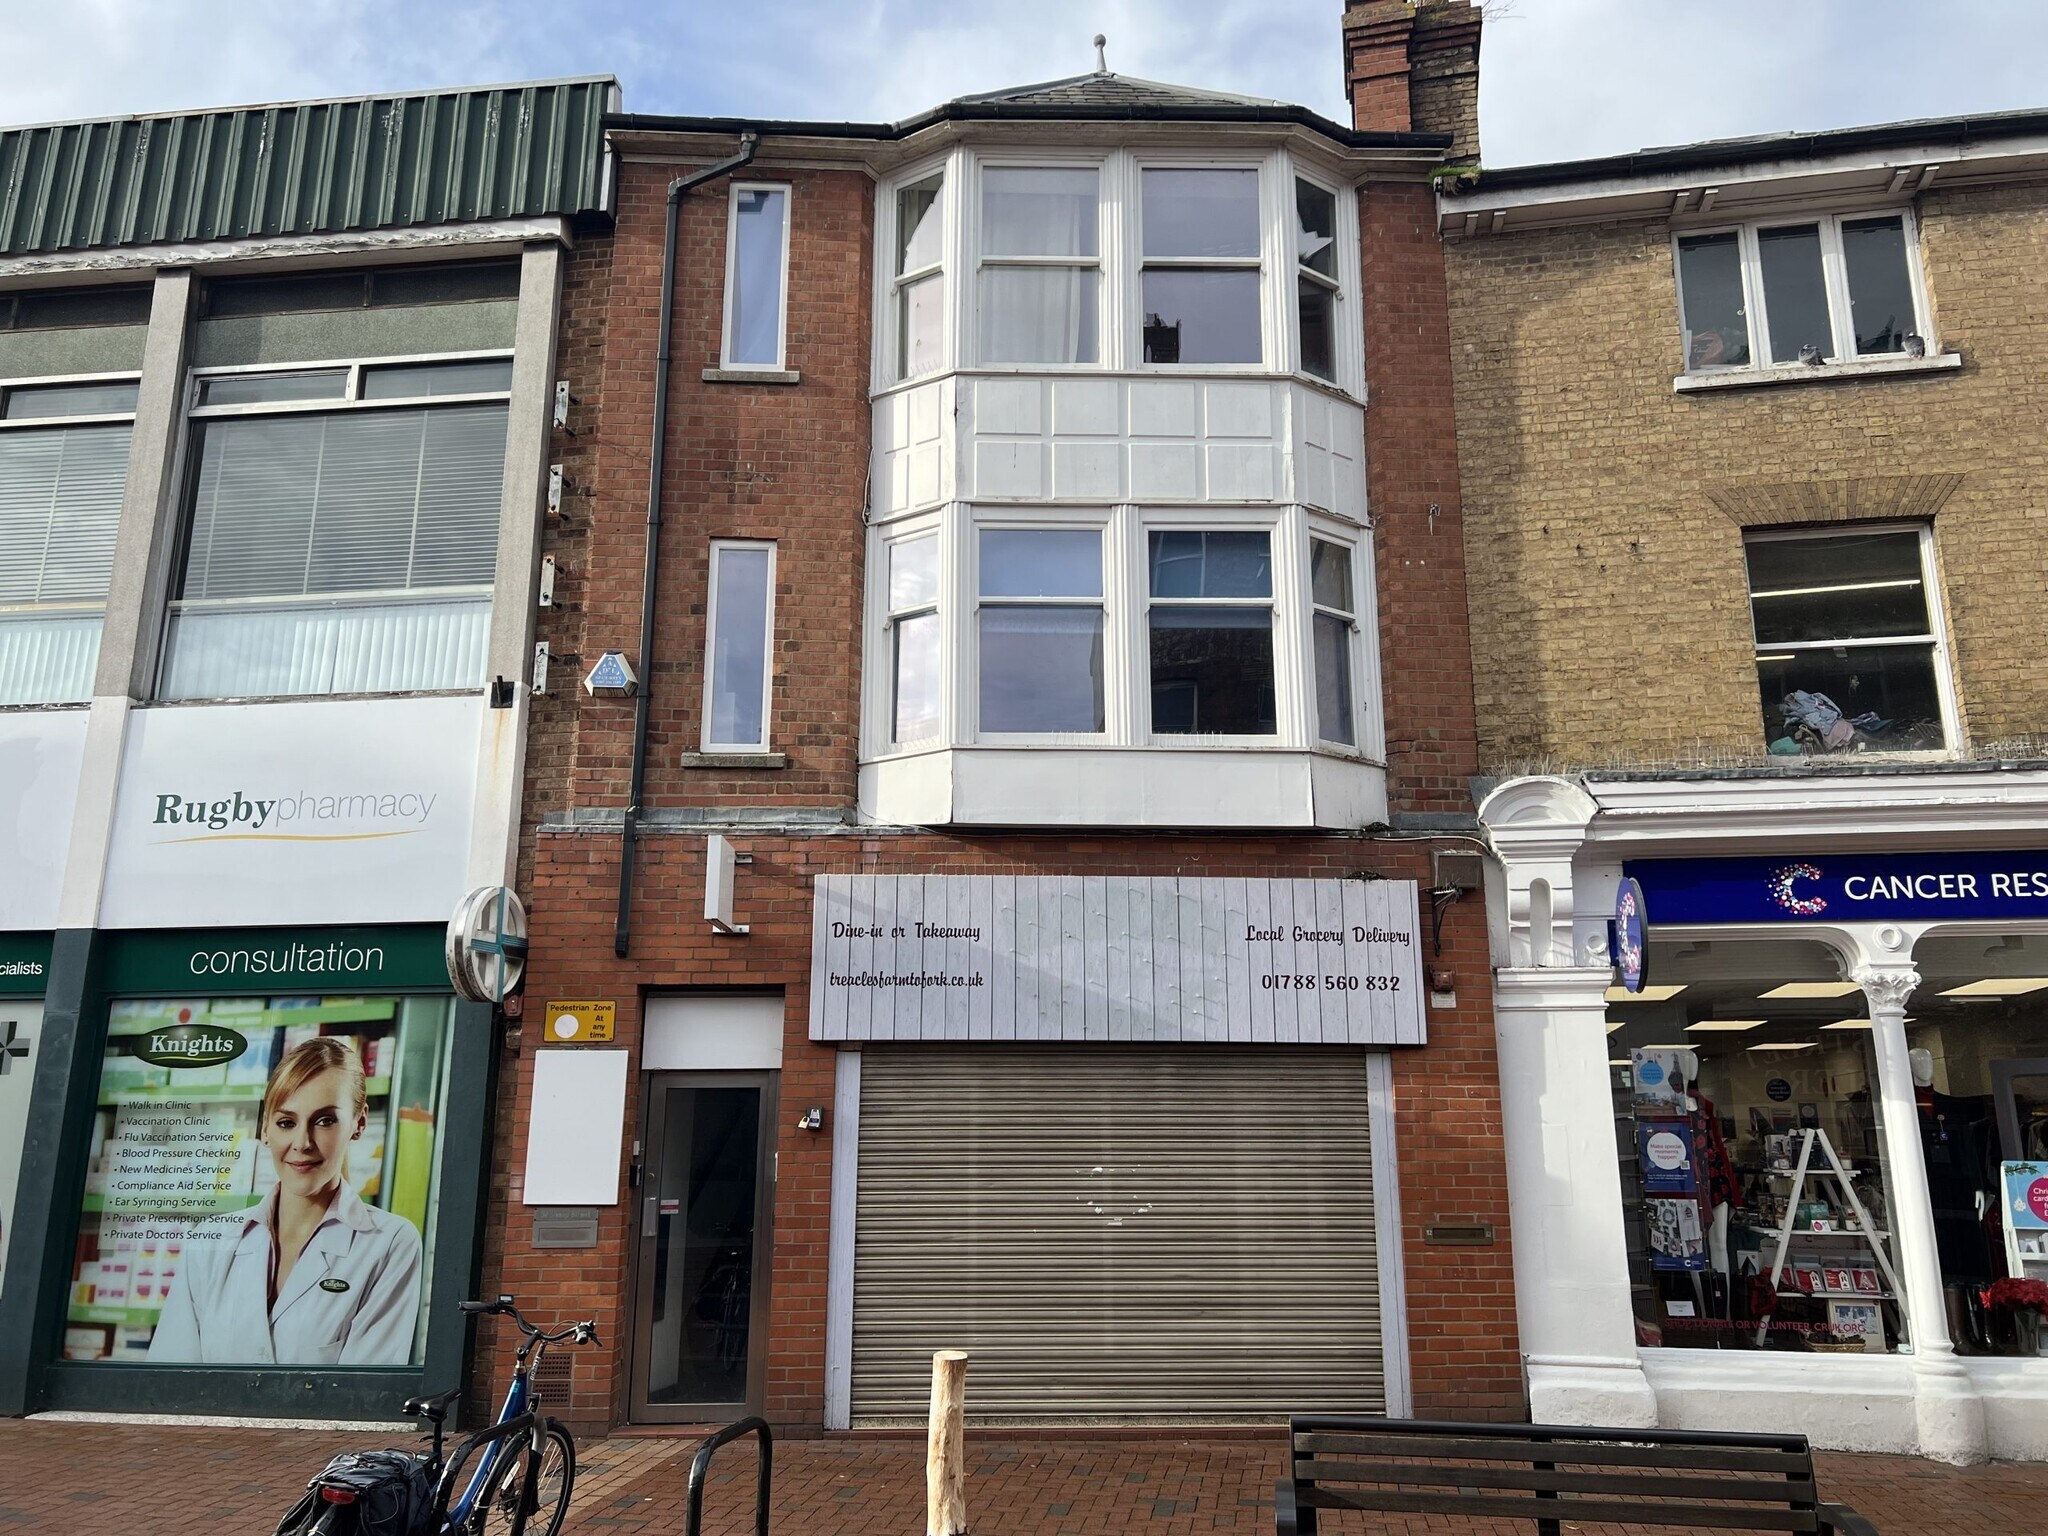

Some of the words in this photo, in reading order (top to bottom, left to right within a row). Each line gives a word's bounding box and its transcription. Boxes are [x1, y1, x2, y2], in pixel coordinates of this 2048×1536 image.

[1844, 874, 1979, 899] CANCER
[1991, 872, 2048, 897] RES
[831, 922, 883, 938] Dine-in
[891, 927, 905, 938] or
[915, 923, 980, 942] Takeaway
[1245, 925, 1284, 941] Local
[1292, 926, 1343, 946] Grocery
[1351, 926, 1410, 947] Delivery
[190, 942, 384, 974] consultation
[830, 971, 984, 989] treaclesfarmtofork.co.uk
[1262, 975, 1316, 990] 01788
[1325, 976, 1359, 990] 560
[1366, 976, 1400, 991] 832
[149, 1034, 234, 1056] Knights
[128, 1101, 151, 1109] Walk
[165, 1101, 192, 1109] Clinic
[126, 1117, 181, 1126] Vaccination
[184, 1117, 211, 1126] Clinic
[124, 1133, 138, 1141] Flu
[141, 1133, 196, 1141] Vaccination
[199, 1133, 234, 1141] Service
[122, 1149, 150, 1157] Blood
[152, 1149, 193, 1158] Pressure
[195, 1149, 241, 1159] Checking
[120, 1165, 141, 1174] New
[143, 1165, 193, 1174] Medicines
[195, 1165, 231, 1173] Service
[117, 1181, 175, 1191] Compliance
[177, 1181, 194, 1190] Aid
[196, 1181, 232, 1190] Service
[115, 1198, 130, 1206] Ear
[132, 1197, 179, 1208] Syringing
[181, 1198, 217, 1206] Service
[112, 1214, 147, 1223] Private
[148, 1214, 206, 1224] Prescription
[208, 1214, 245, 1223] Service
[110, 1230, 144, 1239] Private
[146, 1230, 184, 1240] Doctors
[186, 1230, 222, 1240] Service
[1735, 1320, 1750, 1328] OR
